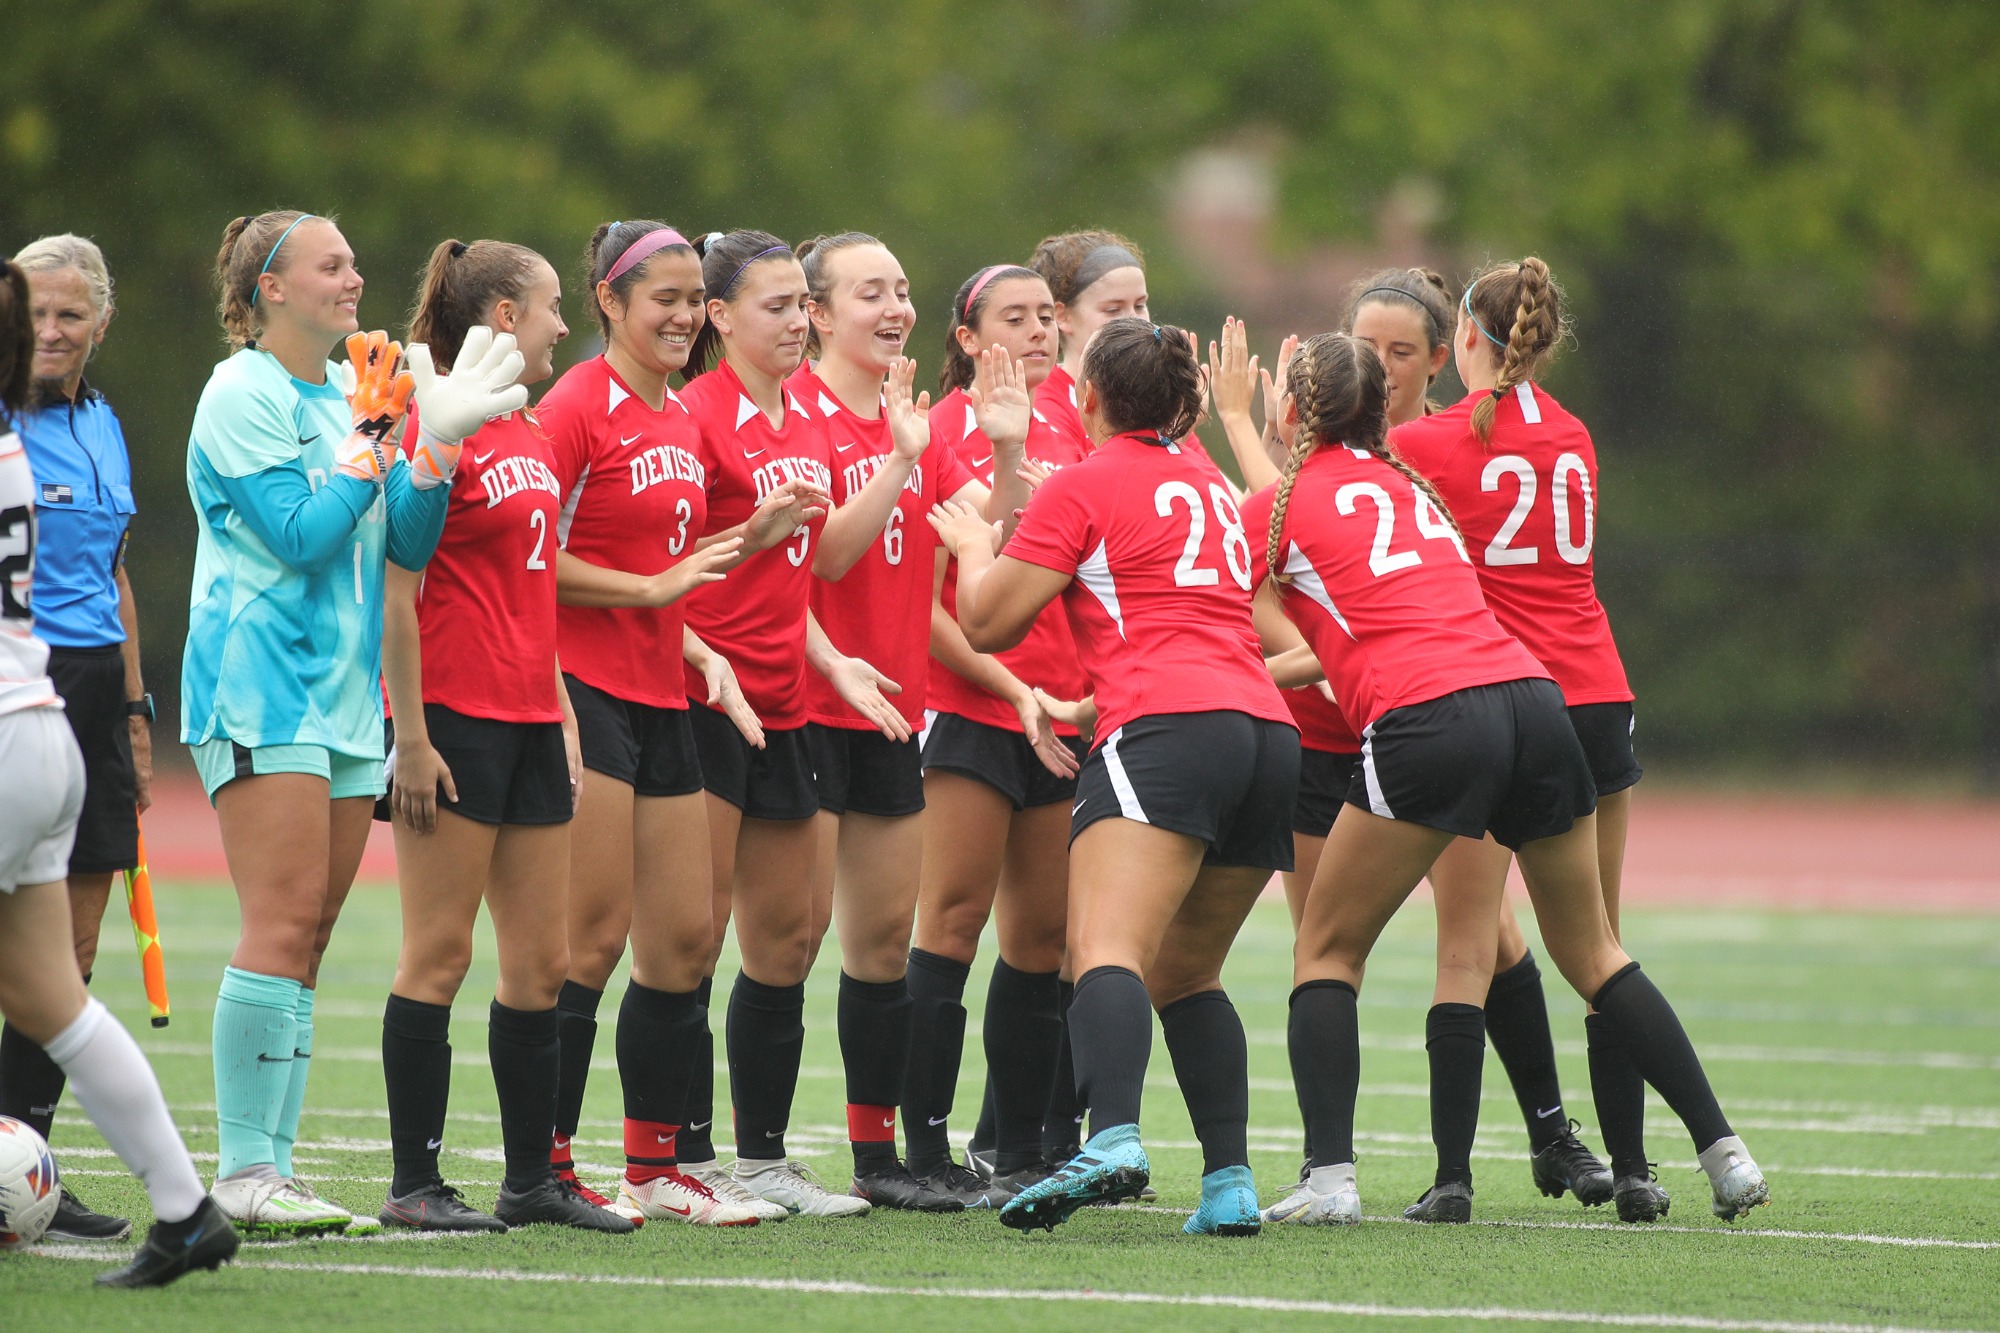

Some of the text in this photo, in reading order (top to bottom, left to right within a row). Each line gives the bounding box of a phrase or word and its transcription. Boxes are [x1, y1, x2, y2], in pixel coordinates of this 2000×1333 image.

[371, 441, 387, 475] HAGUE
[526, 508, 547, 570] 2
[668, 498, 692, 556] 3
[884, 506, 904, 566] 6
[1154, 480, 1252, 592] 28
[1335, 481, 1472, 578] 24
[1481, 453, 1594, 566] 20
[353, 541, 364, 605] 1
